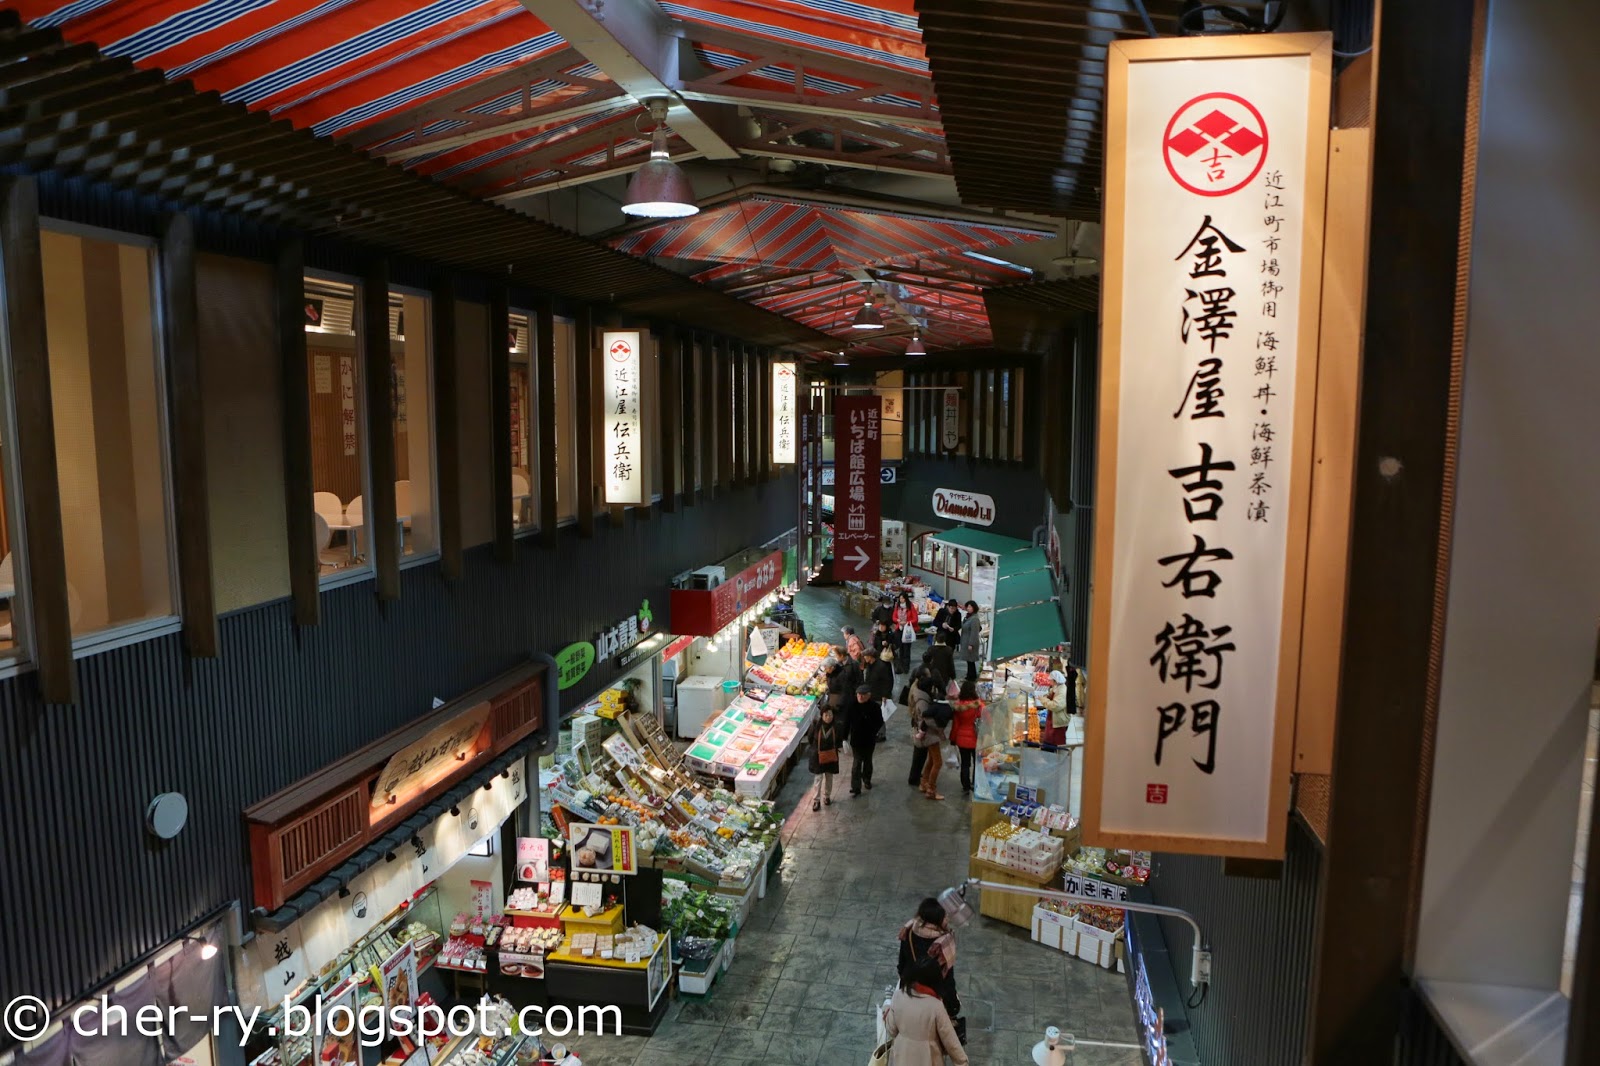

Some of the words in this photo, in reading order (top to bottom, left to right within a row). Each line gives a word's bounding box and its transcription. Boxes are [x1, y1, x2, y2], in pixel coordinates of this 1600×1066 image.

[1200, 146, 1233, 183] 吉
[1260, 170, 1287, 319] 近江町市場御用
[612, 367, 633, 482] 近江屋伝兵衛
[867, 408, 878, 441] 近江町
[849, 409, 866, 502] いちば館広場
[935, 493, 979, 518] Diamond
[1150, 214, 1247, 775] 金澤屋吉右衛門
[838, 532, 875, 541] エレベーター
[596, 615, 638, 664] 山本青果
[274, 937, 295, 986] 越山
